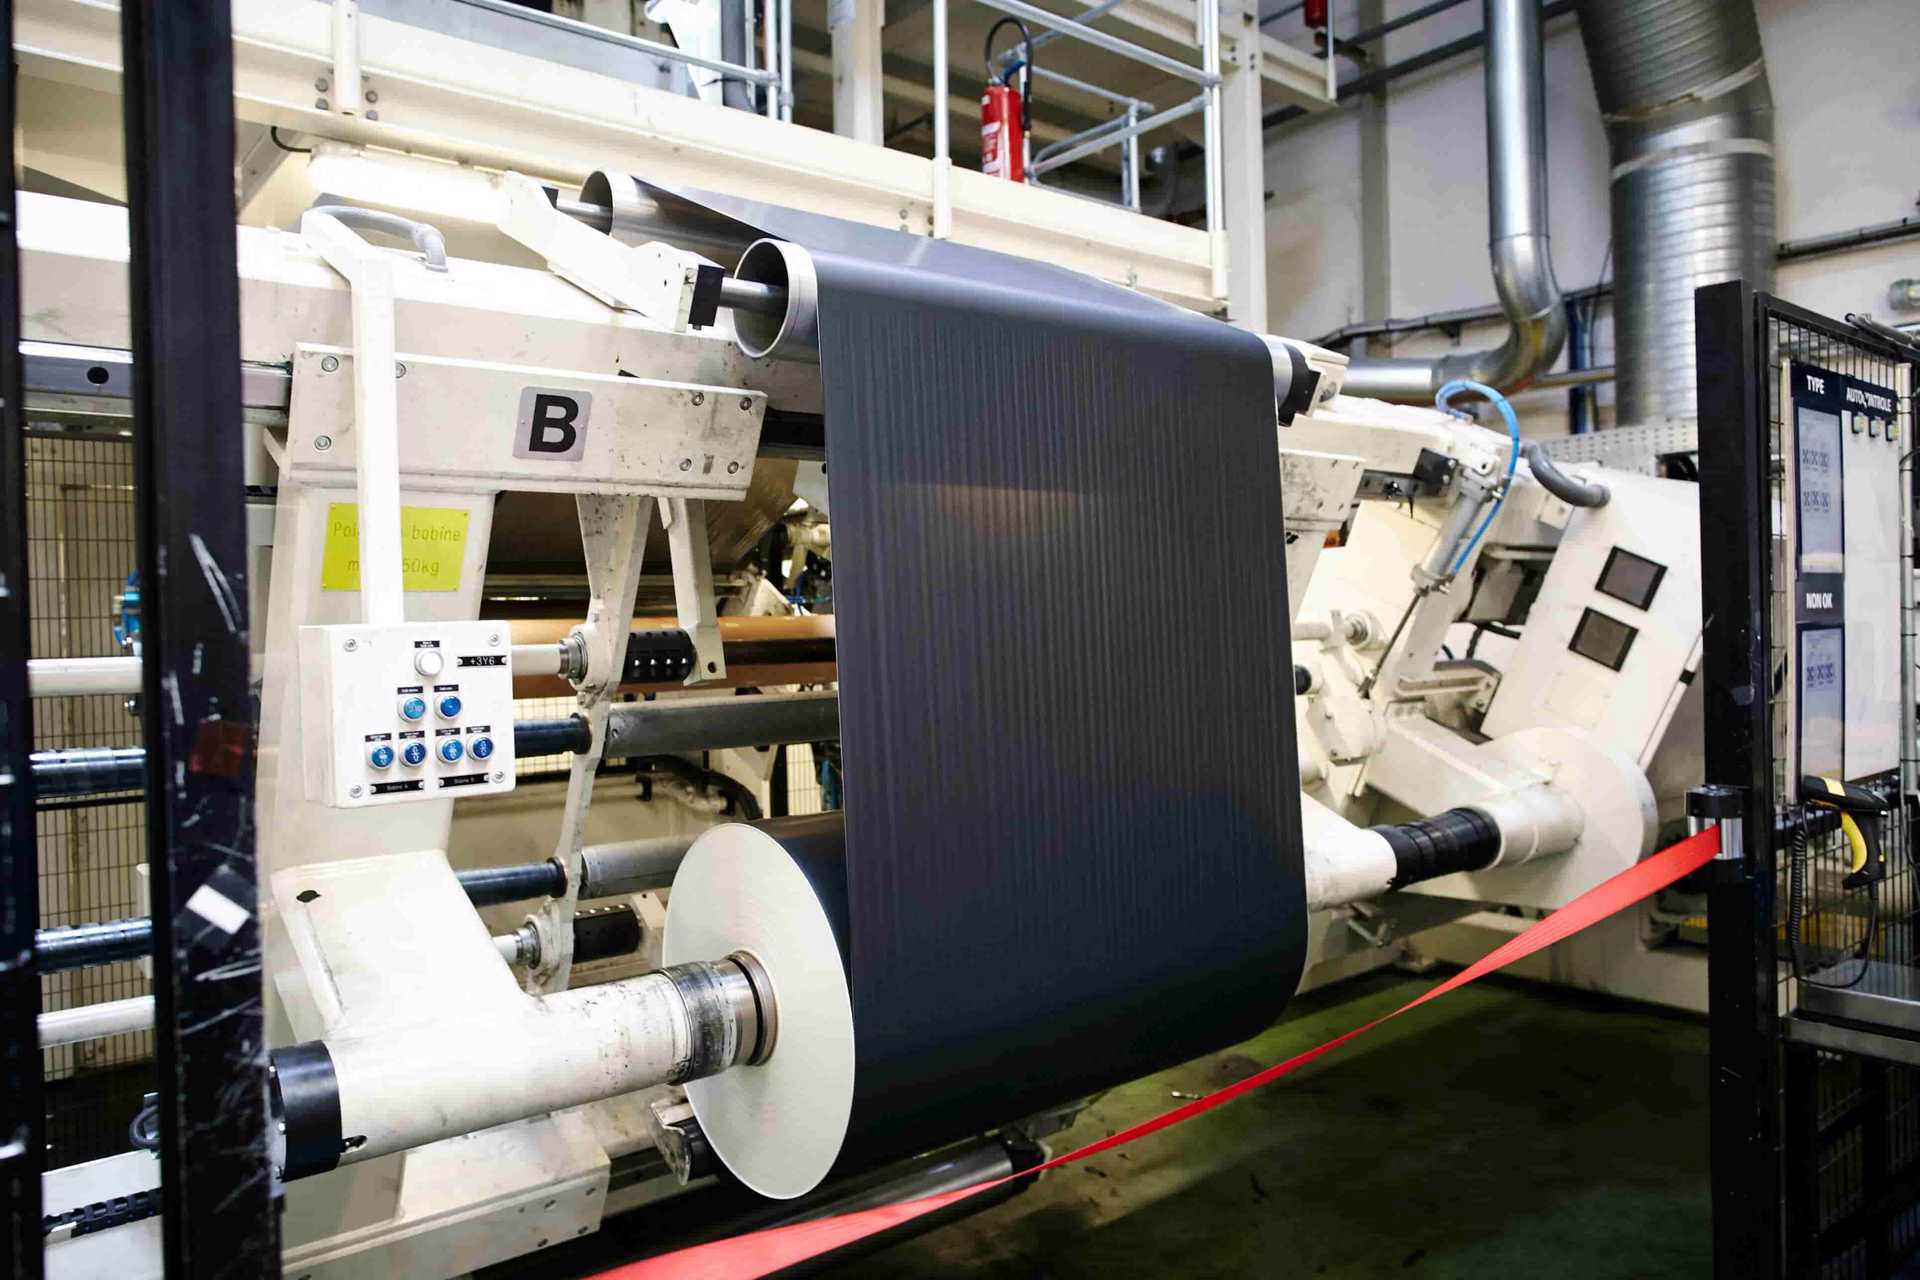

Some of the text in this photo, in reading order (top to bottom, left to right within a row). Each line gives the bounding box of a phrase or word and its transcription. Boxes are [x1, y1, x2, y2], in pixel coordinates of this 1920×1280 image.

[1806, 374, 1825, 395] TYPE
[528, 393, 579, 453] B
[411, 524, 462, 542] bobine
[1806, 592, 1833, 609] NON OK
[470, 656, 495, 666] +3Y6
